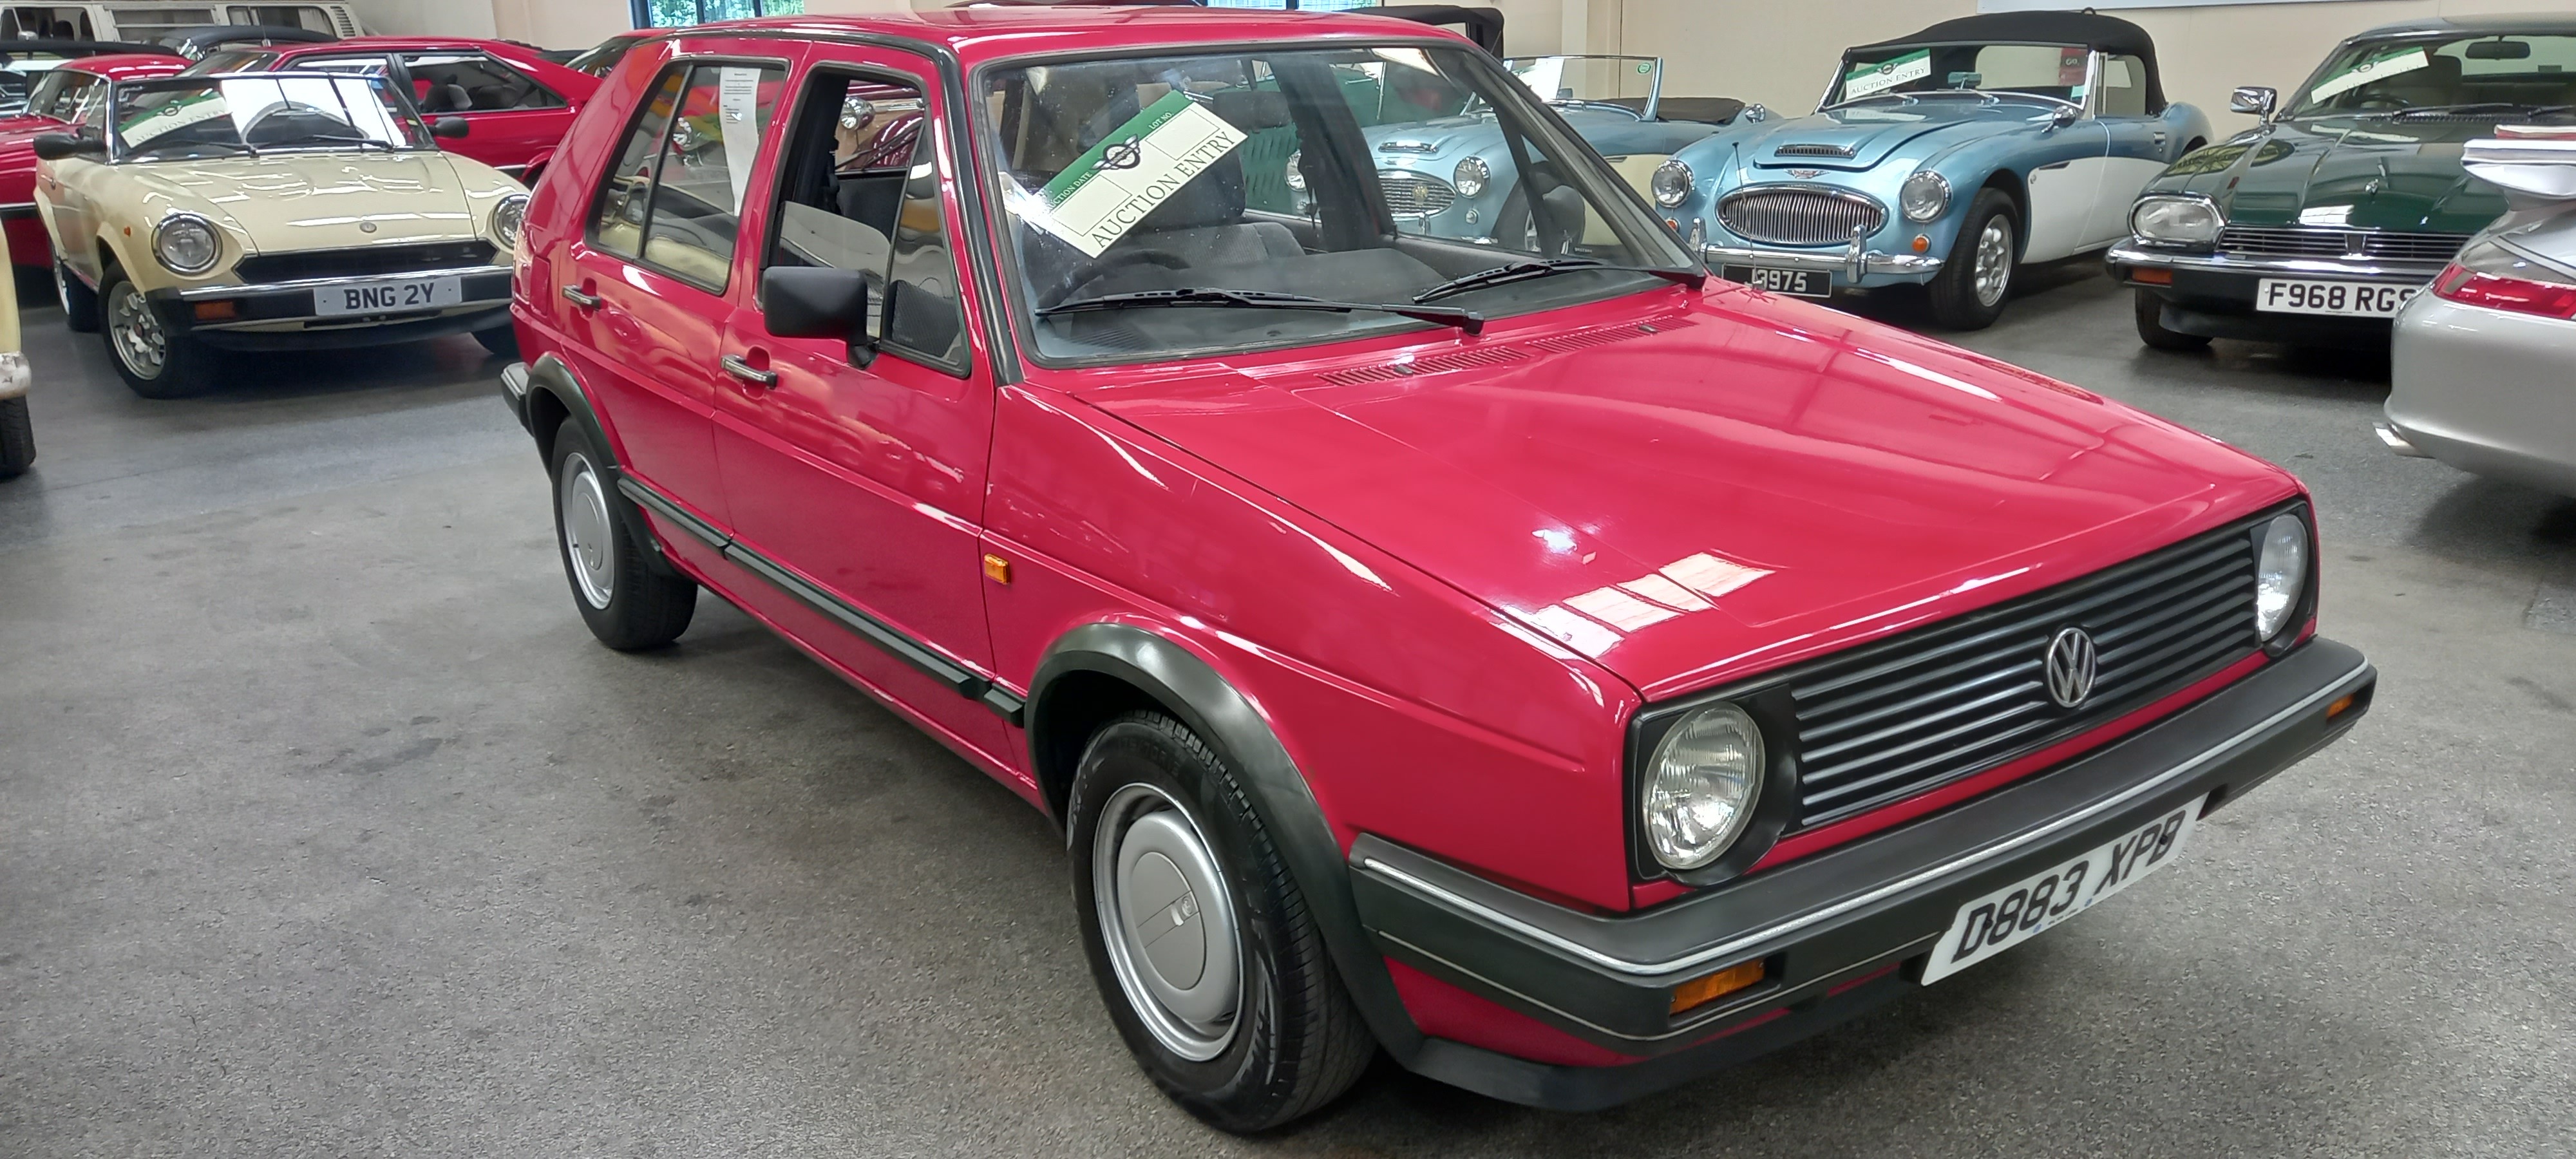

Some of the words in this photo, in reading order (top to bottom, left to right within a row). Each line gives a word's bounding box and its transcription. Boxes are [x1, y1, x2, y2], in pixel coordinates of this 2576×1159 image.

[1851, 79, 1893, 94] AUCTION
[1896, 68, 1926, 80] ENTRY
[1148, 118, 1163, 129] LOT
[1049, 185, 1076, 209] UCTION
[1073, 171, 1093, 187] DATE
[1091, 173, 1181, 249] AUCTION
[1173, 131, 1236, 178] ENTRY
[344, 286, 396, 310] BNG
[404, 282, 434, 305] 2Y
[2268, 283, 2347, 310] F968
[2049, 629, 2094, 706] VW
[1951, 860, 2090, 964] D883
[2094, 810, 2186, 896] XPB
